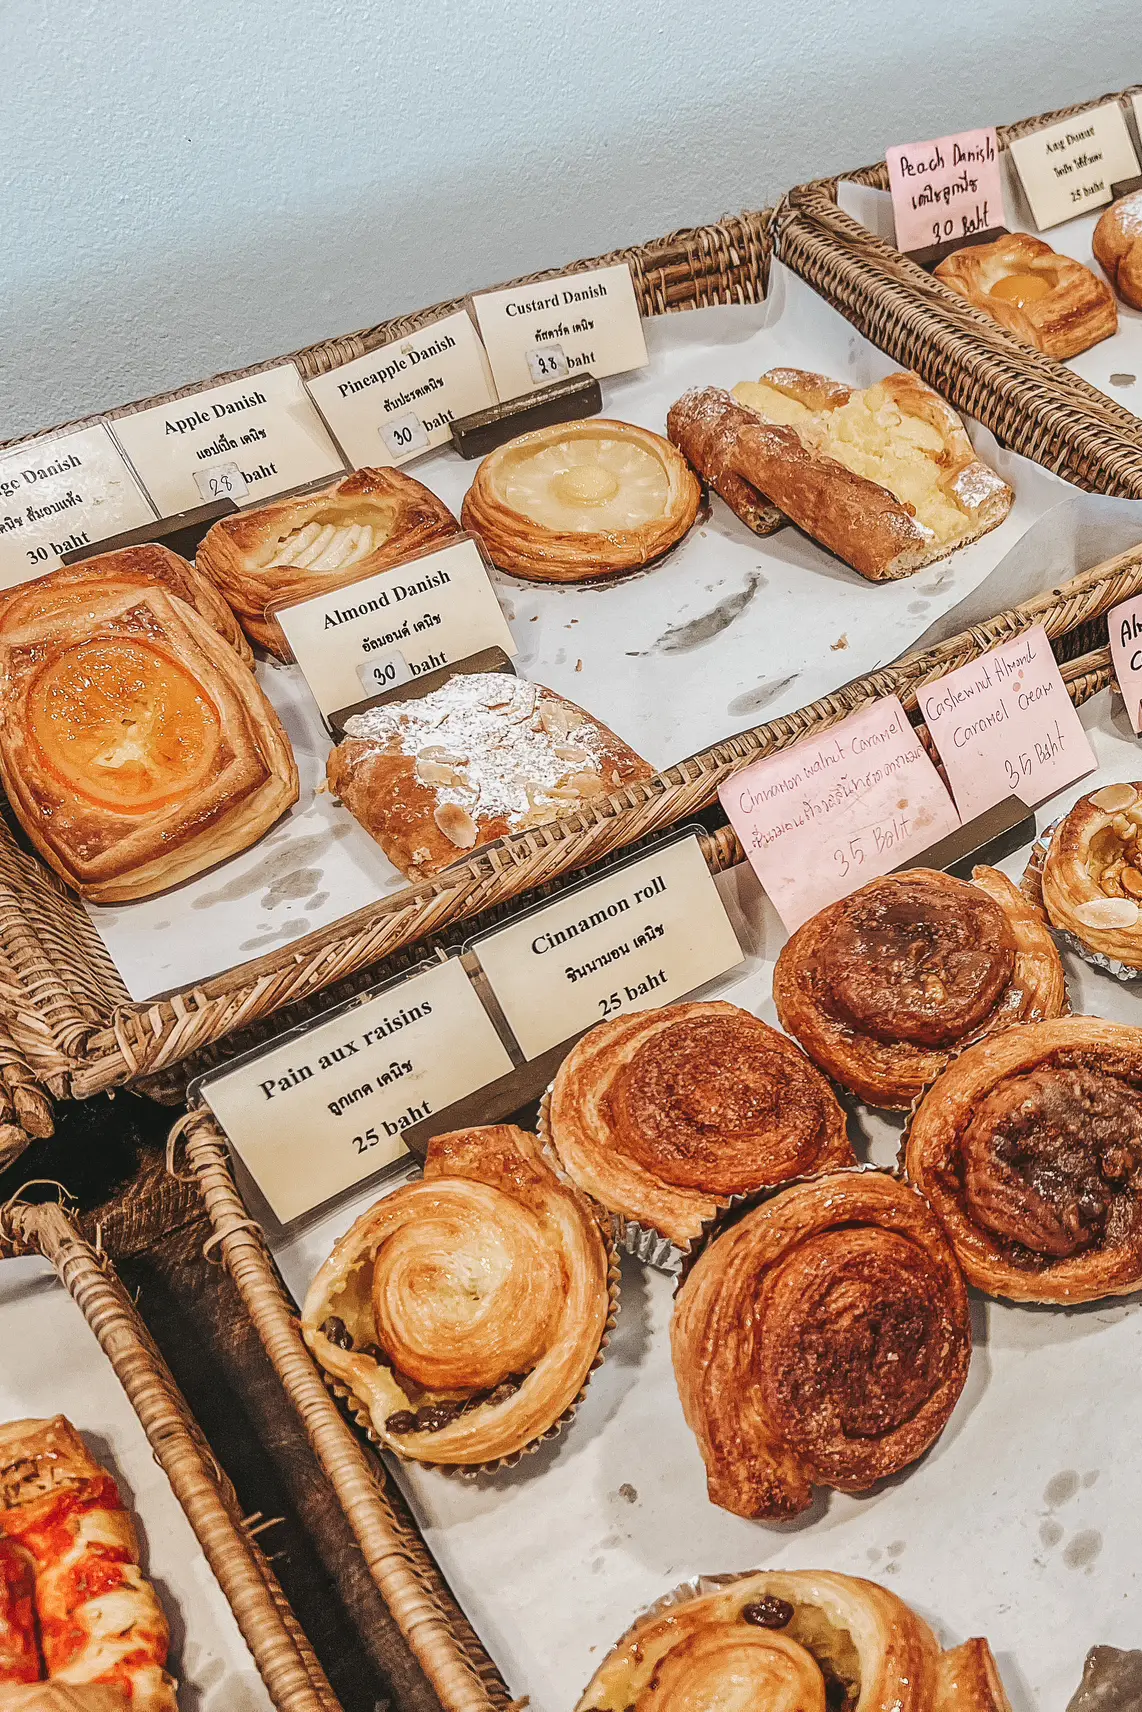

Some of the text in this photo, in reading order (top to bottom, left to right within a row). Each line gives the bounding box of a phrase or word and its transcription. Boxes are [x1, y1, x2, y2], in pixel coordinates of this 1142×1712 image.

[900, 136, 995, 178] Peach Danish
[505, 283, 608, 317] Custard Danish
[337, 335, 457, 398] Pineapple Danish
[566, 351, 597, 369] baht
[165, 391, 267, 435] Apple Danish
[393, 408, 456, 446] 30 baht
[0, 454, 82, 497] ge Danish
[240, 462, 278, 484] baht
[26, 530, 91, 565] 30 baht
[324, 570, 451, 630] Almond Danish
[373, 651, 448, 686] 30 baht
[994, 641, 1037, 682] Almond
[953, 698, 1010, 748] Caramel
[1004, 719, 1065, 790] 35 Baht
[739, 774, 803, 814] Cinnamon
[803, 740, 846, 779] walnut
[833, 837, 866, 878] 35
[531, 875, 668, 955] Cinnamon roll
[598, 968, 669, 1017] 25 baht
[258, 1000, 433, 1101] Pain aux raisins
[352, 1100, 434, 1155] 25 baht
